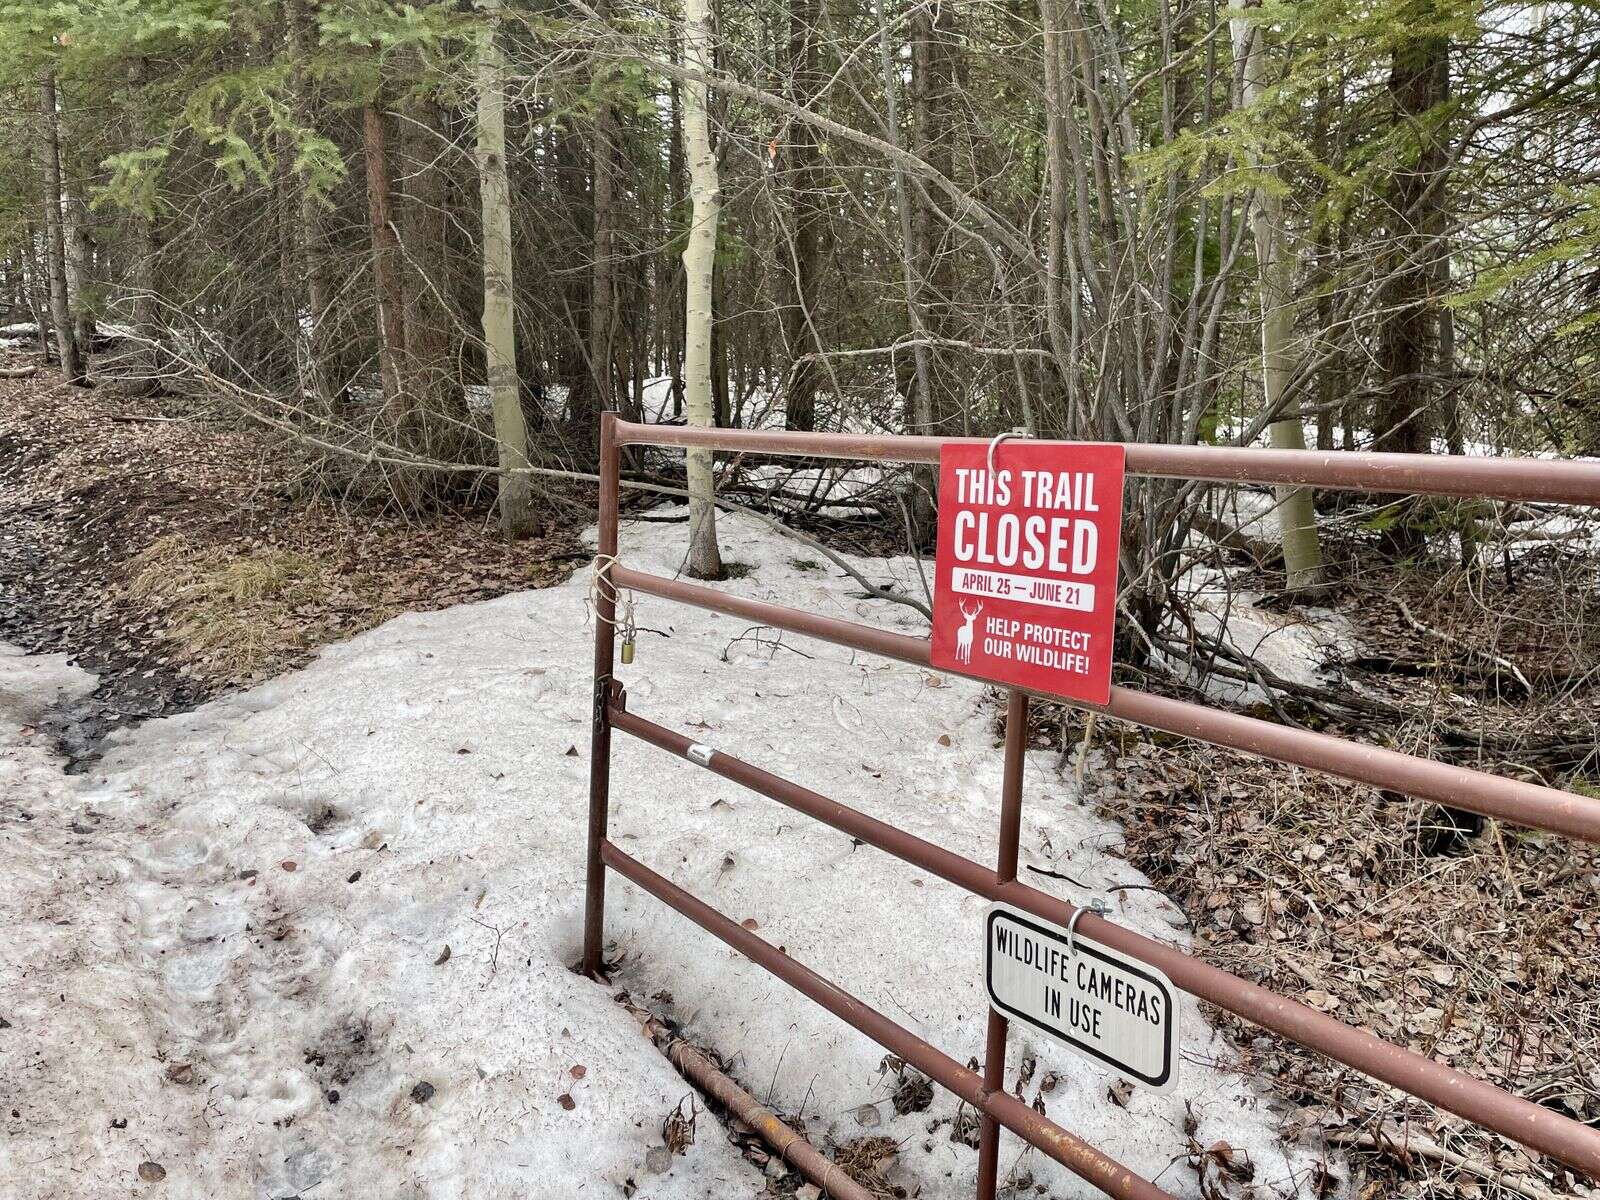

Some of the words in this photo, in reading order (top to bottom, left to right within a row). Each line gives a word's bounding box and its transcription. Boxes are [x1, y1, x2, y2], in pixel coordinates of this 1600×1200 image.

[956, 469, 1011, 506] THIS
[1022, 470, 1099, 512] TRAIL
[954, 511, 1098, 575] CLOSED
[962, 572, 993, 594] APRIL
[997, 577, 1011, 595] 25
[1029, 582, 1062, 603] JUNE
[1066, 588, 1080, 606] 21
[986, 616, 1021, 638] HELP
[1024, 621, 1091, 651] PROTECT
[984, 637, 1012, 660] OUR
[1016, 643, 1089, 674] WILDLIFE!
[996, 925, 1069, 983] WILDLIFE
[1076, 961, 1161, 1026] CAMERAS
[1044, 986, 1061, 1019] IN
[1069, 997, 1102, 1039] USE
